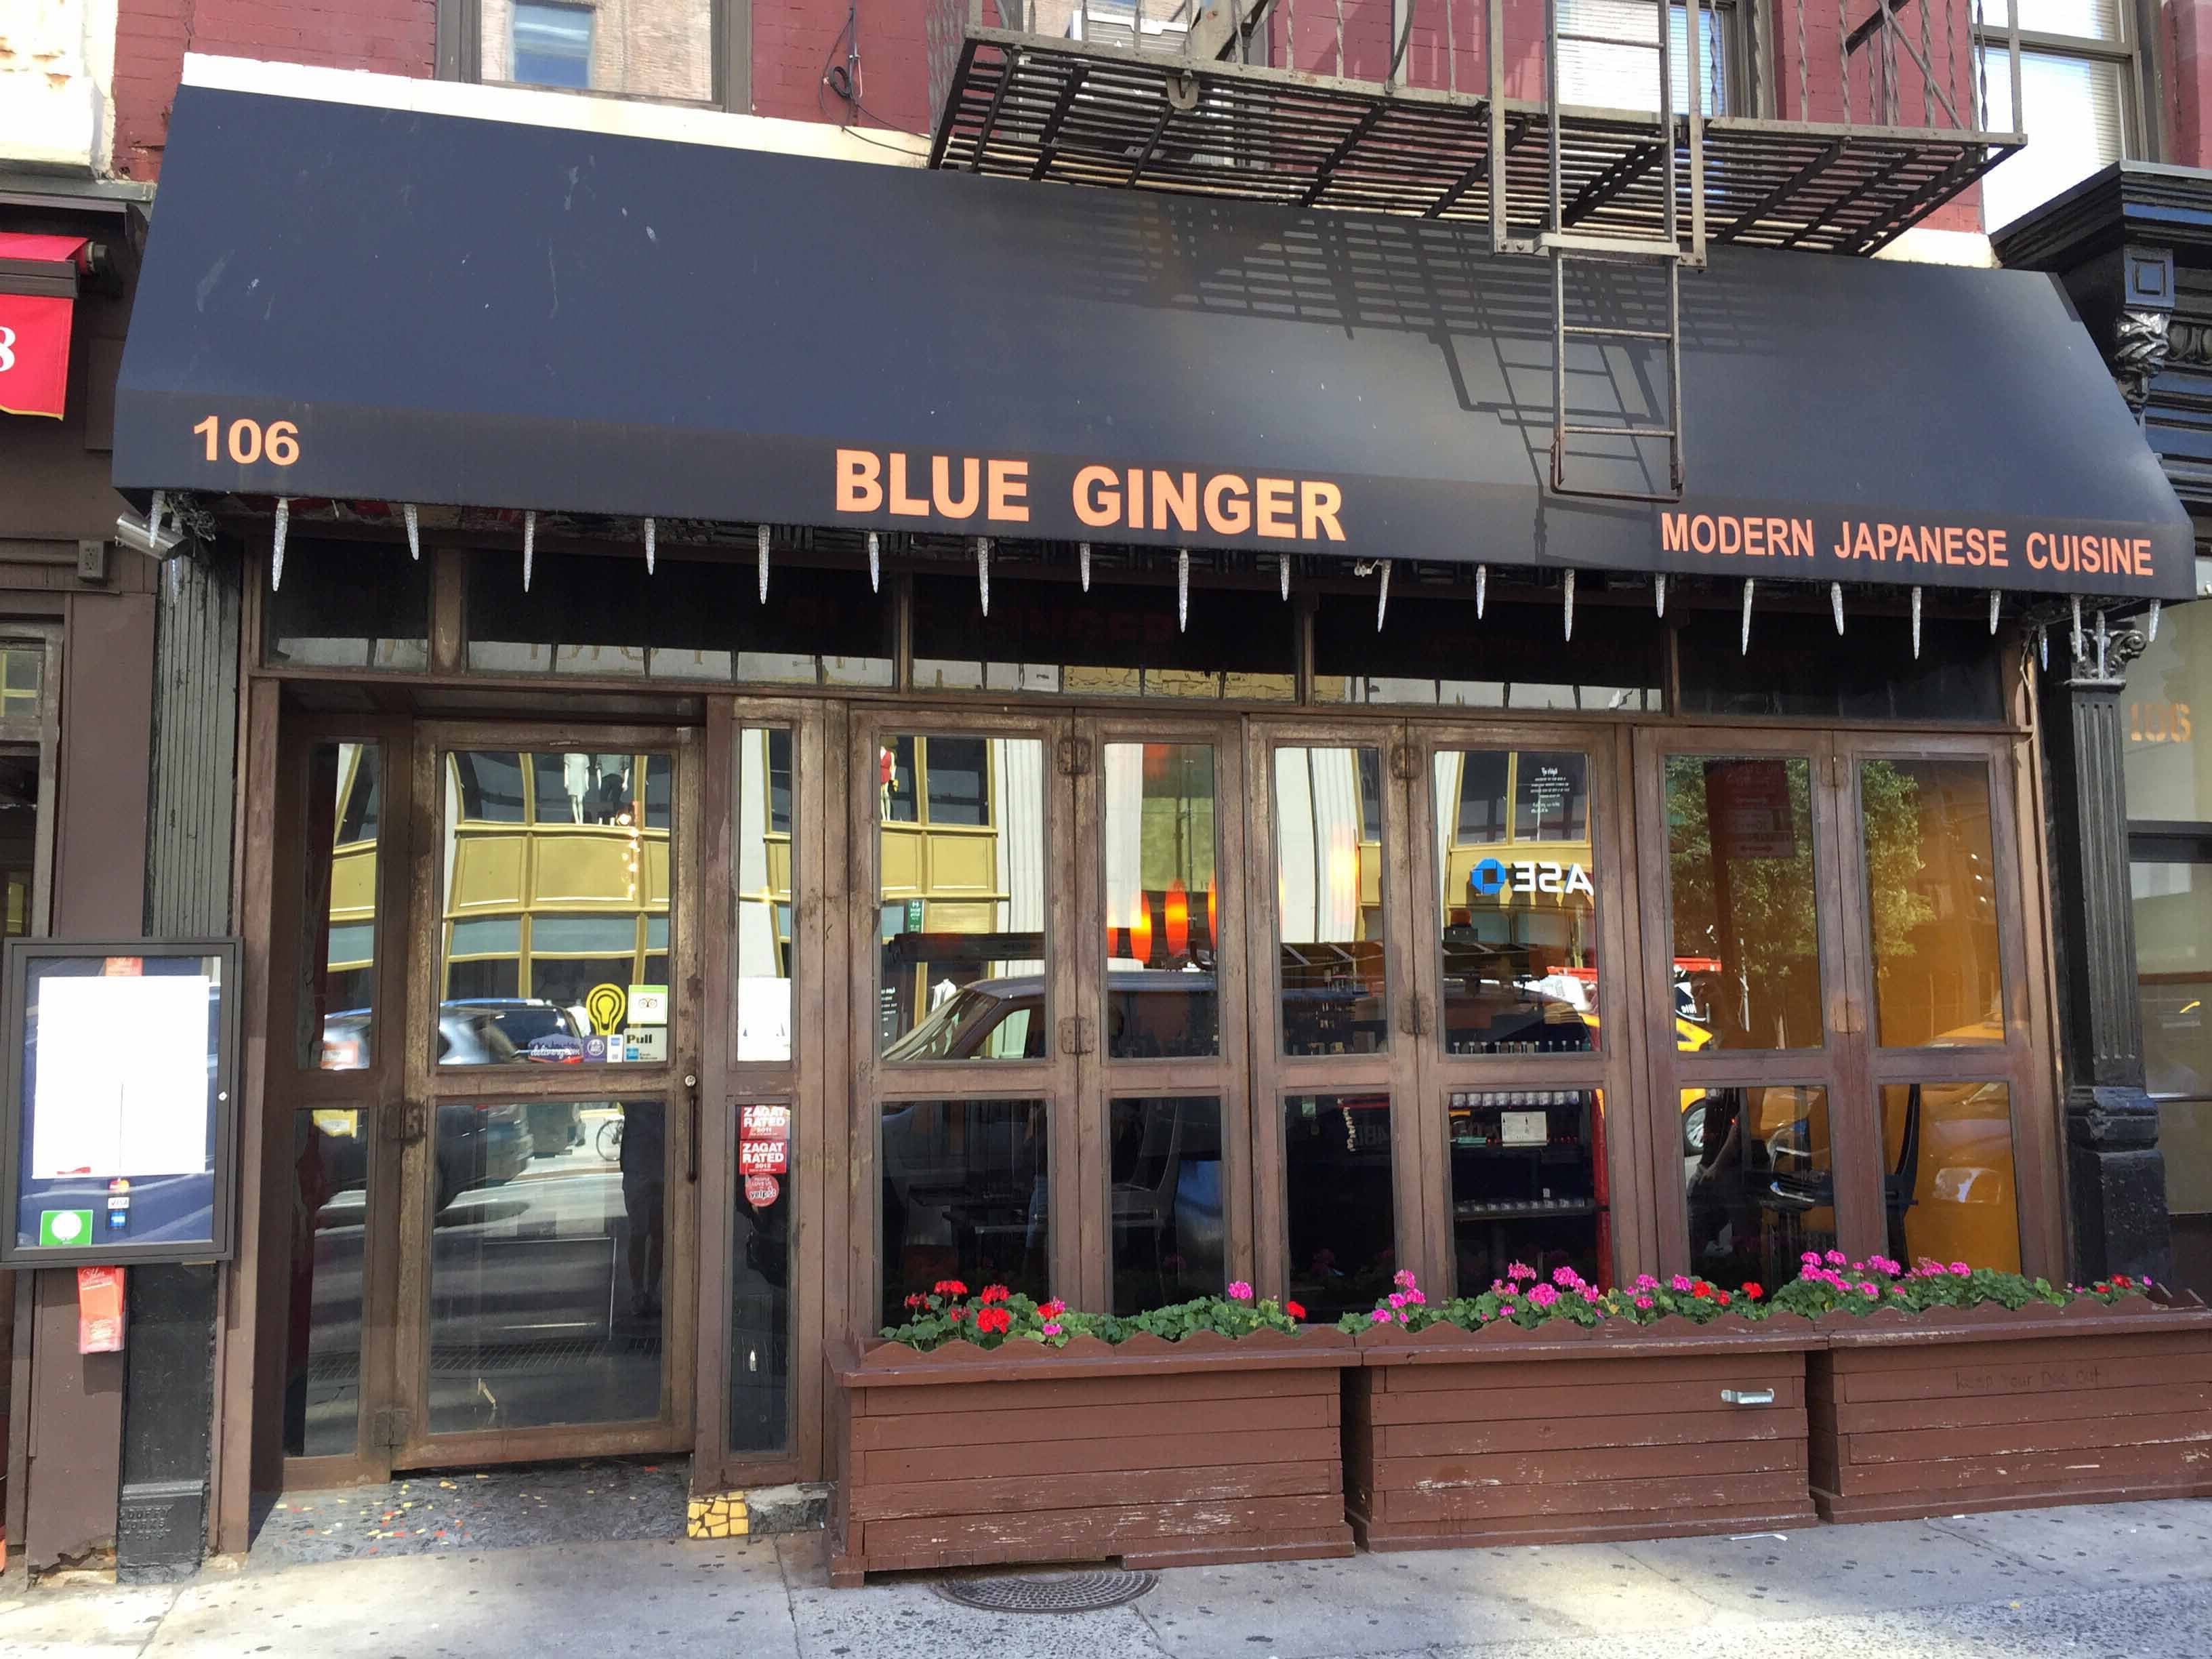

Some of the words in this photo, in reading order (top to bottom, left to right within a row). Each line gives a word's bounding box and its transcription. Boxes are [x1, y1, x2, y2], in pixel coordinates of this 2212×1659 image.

[193, 415, 300, 466] 106
[836, 448, 1029, 522] BLUE
[1072, 465, 1347, 541] GINGER
[1660, 512, 1815, 557] MODERN
[1833, 520, 2009, 567] JAPANESE
[2025, 531, 2154, 577] CUISINE
[626, 1033, 653, 1044] Pull
[743, 1105, 785, 1117] ZAGAT
[743, 1117, 786, 1128] RATED
[742, 1142, 785, 1153] ZAGAT
[742, 1153, 785, 1164] RATED
